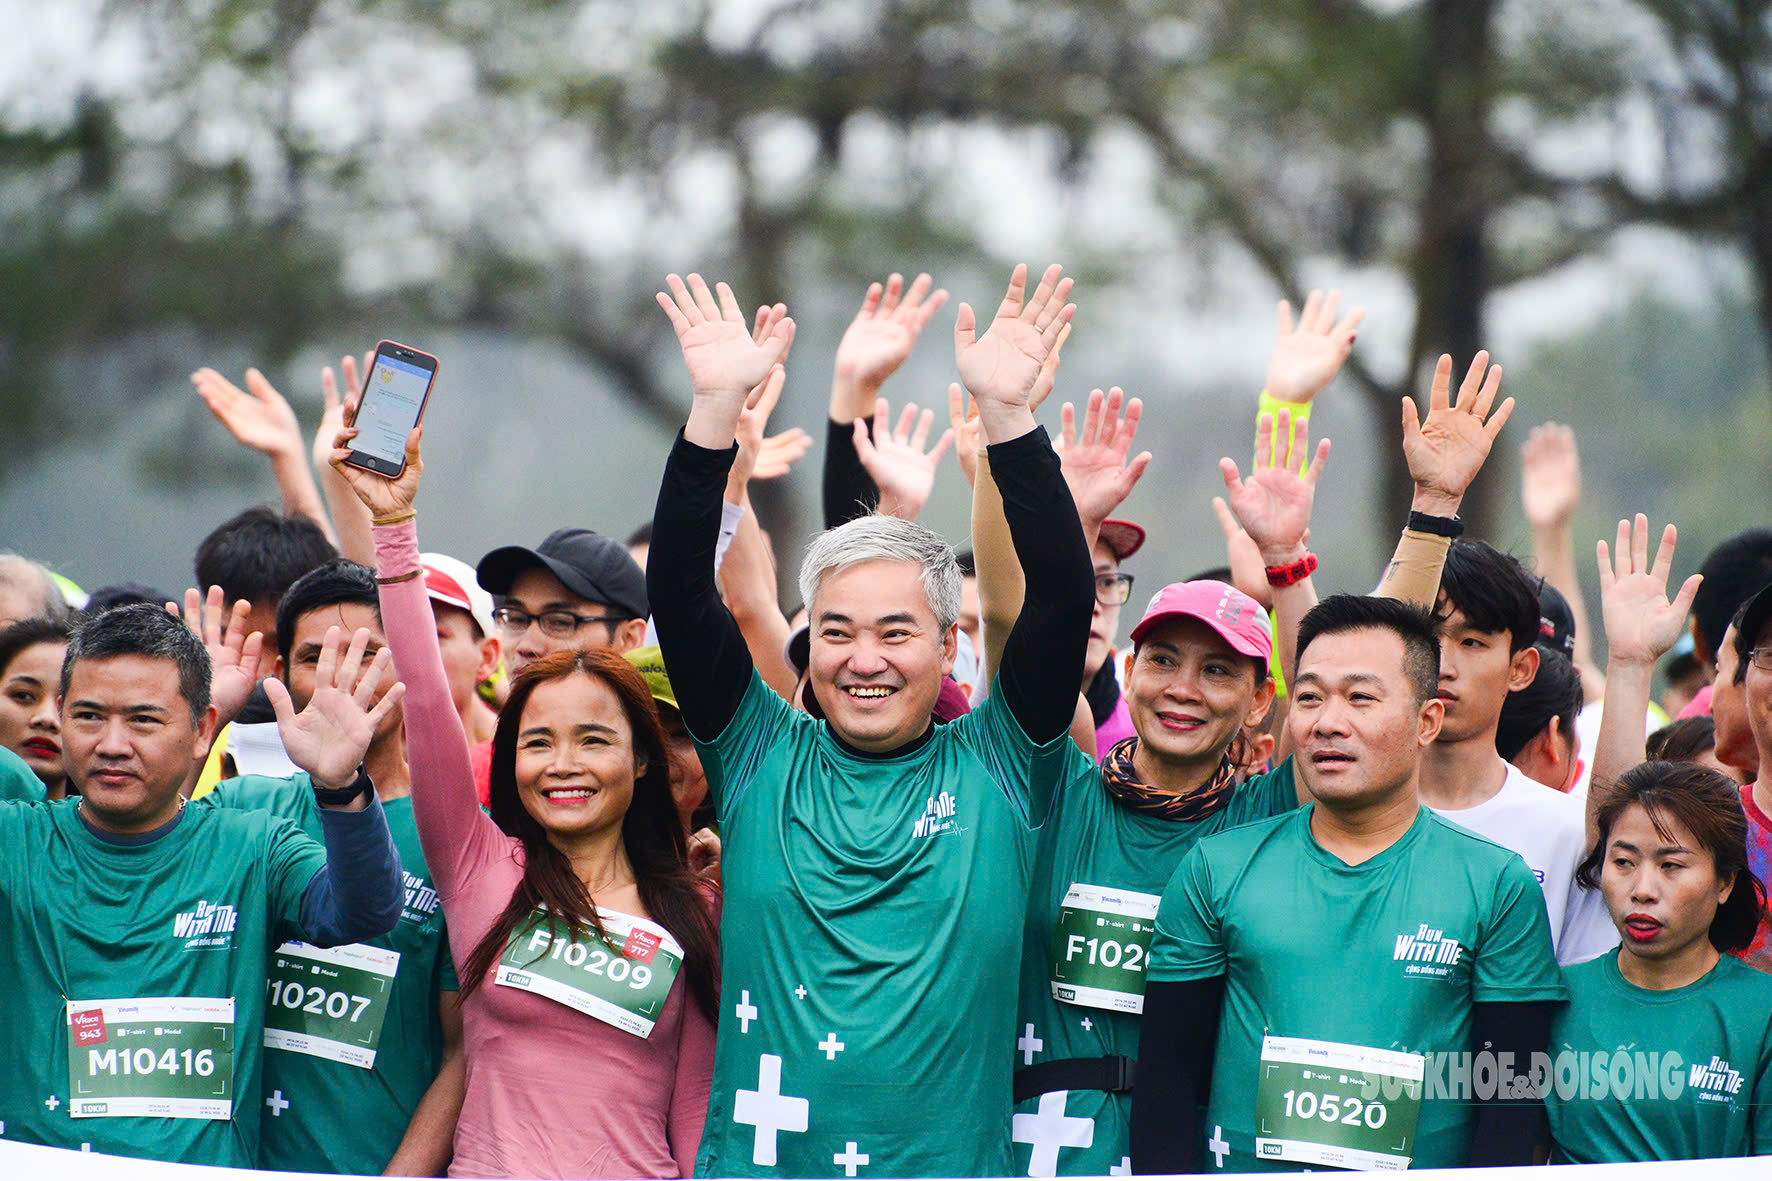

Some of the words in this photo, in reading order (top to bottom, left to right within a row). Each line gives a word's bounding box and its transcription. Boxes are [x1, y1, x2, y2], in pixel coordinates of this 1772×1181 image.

[1105, 920, 1125, 928] T-shirt
[1416, 923, 1443, 943] RUN
[528, 929, 653, 990] F10209
[631, 946, 649, 957] 717
[1066, 934, 1151, 972] F102
[1392, 935, 1438, 962] WITH
[1434, 938, 1464, 965] ME
[505, 972, 531, 986] 10KM
[266, 978, 371, 1022] 10207
[80, 1029, 103, 1040] 943
[88, 1047, 215, 1077] M10416
[1312, 1072, 1331, 1080] T-shirt
[1349, 1078, 1367, 1086] Medal
[1689, 1064, 1727, 1091] WITH
[83, 1104, 107, 1113] 10KM
[1283, 1090, 1387, 1130] 10520
[1263, 1144, 1281, 1155] 10KM
